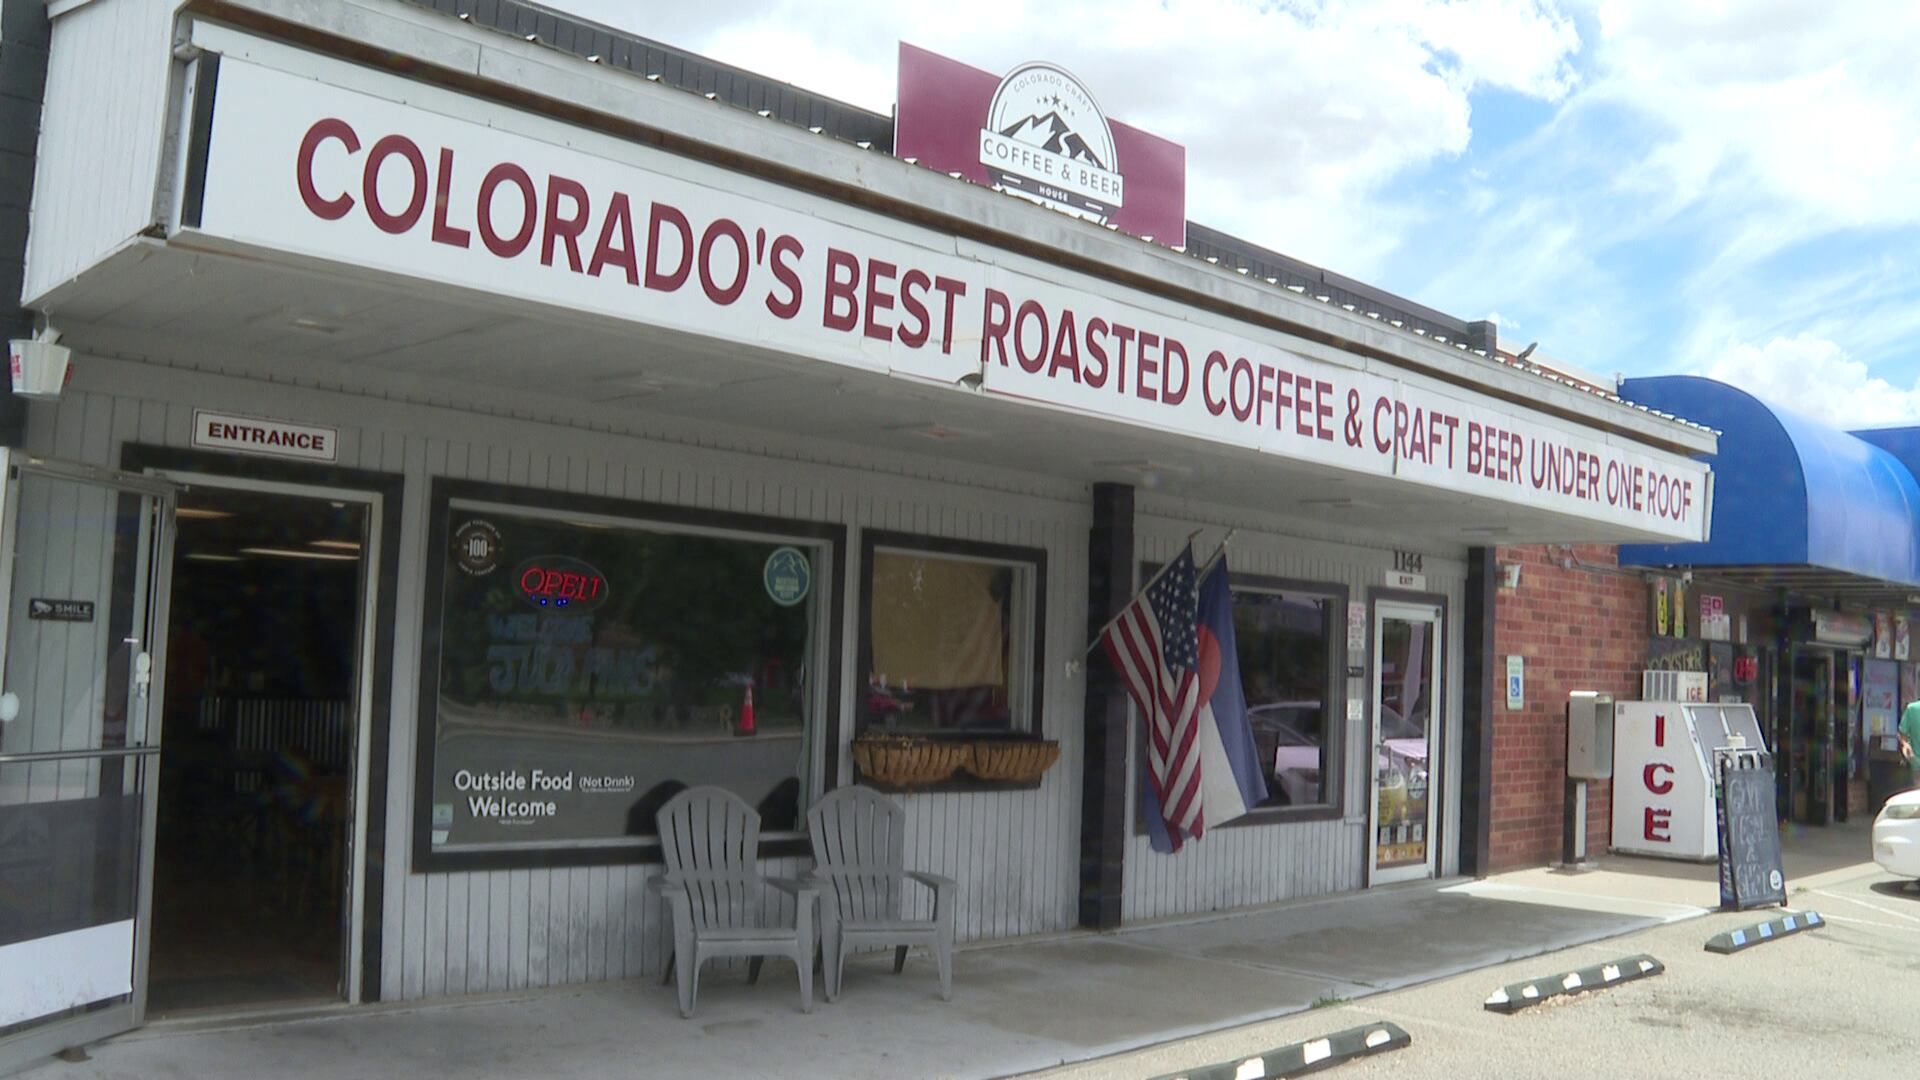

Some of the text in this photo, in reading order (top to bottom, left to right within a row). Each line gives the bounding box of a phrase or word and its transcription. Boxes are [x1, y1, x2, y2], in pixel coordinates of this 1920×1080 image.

[1014, 74, 1062, 93] COLORADO
[983, 138, 1120, 197] COFFEE & BEER
[1039, 186, 1069, 202] HOUSE
[298, 119, 1693, 522] COLORADO'S BEST ROASTED COFFEE & CRAFT BEER UNDER ONE ROOF
[208, 421, 325, 451] ENTRANCE
[469, 539, 488, 557] 100
[1394, 549, 1422, 573] 1144
[520, 565, 601, 602] OPEN
[1399, 575, 1414, 585] EXIT
[55, 603, 91, 614] SMILE
[1686, 687, 1703, 702] ICE
[454, 769, 635, 792] Outside Food (Not Drink)
[1643, 714, 1675, 842] ICE
[468, 795, 557, 818] Welcome
